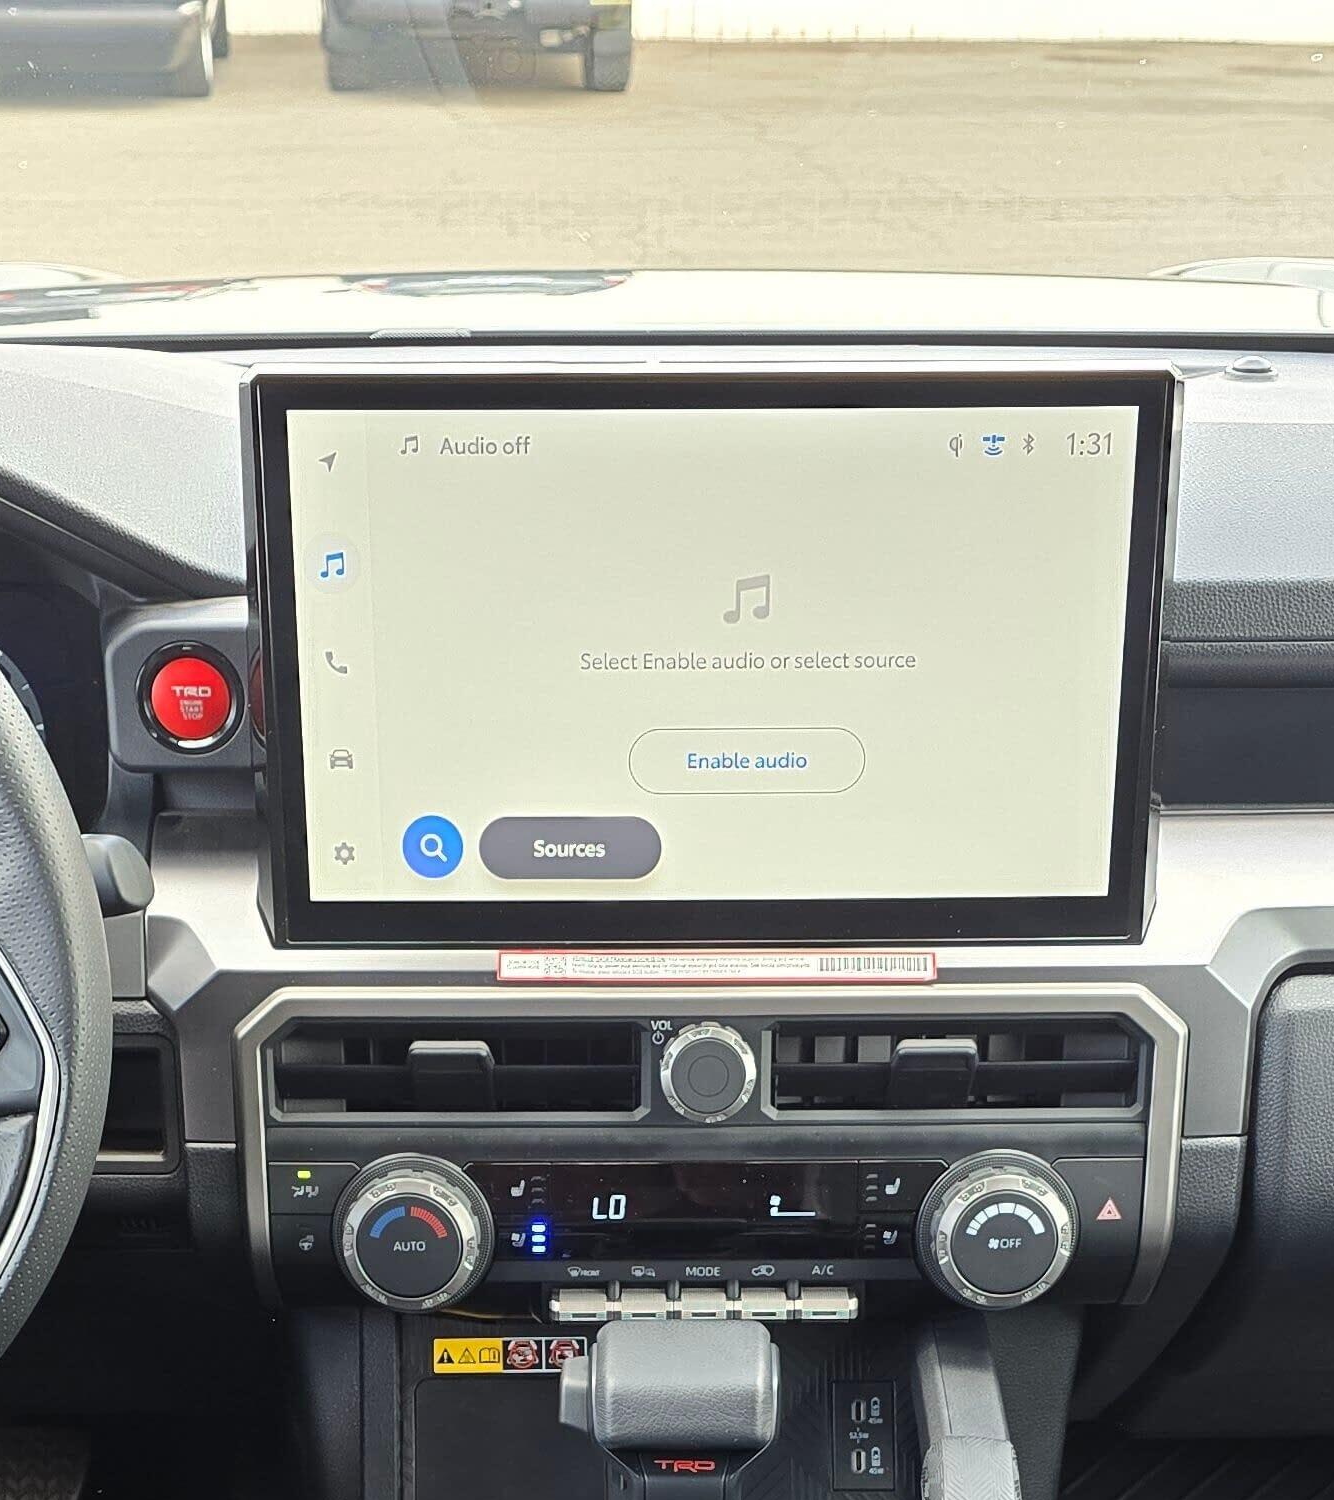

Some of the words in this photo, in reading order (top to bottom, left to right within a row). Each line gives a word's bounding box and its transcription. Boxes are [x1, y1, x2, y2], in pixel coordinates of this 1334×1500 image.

[440, 436, 497, 455] Audio
[503, 436, 530, 455] off
[1067, 432, 1112, 455] 1:31
[581, 653, 637, 670] Select
[643, 652, 707, 670] Enable
[712, 652, 765, 669] audio
[770, 655, 790, 669] or
[794, 652, 849, 669] select
[854, 655, 916, 668] source
[171, 686, 211, 697] TRD
[687, 753, 749, 769] Enable
[755, 752, 807, 768] audio
[533, 840, 606, 858] Sources
[650, 1020, 673, 1031] VOL
[393, 1241, 426, 1251] AUTO
[1000, 1238, 1022, 1249] OFF
[685, 1266, 720, 1277] MODE
[811, 1265, 834, 1276] A/C
[654, 1460, 715, 1473] TRD
